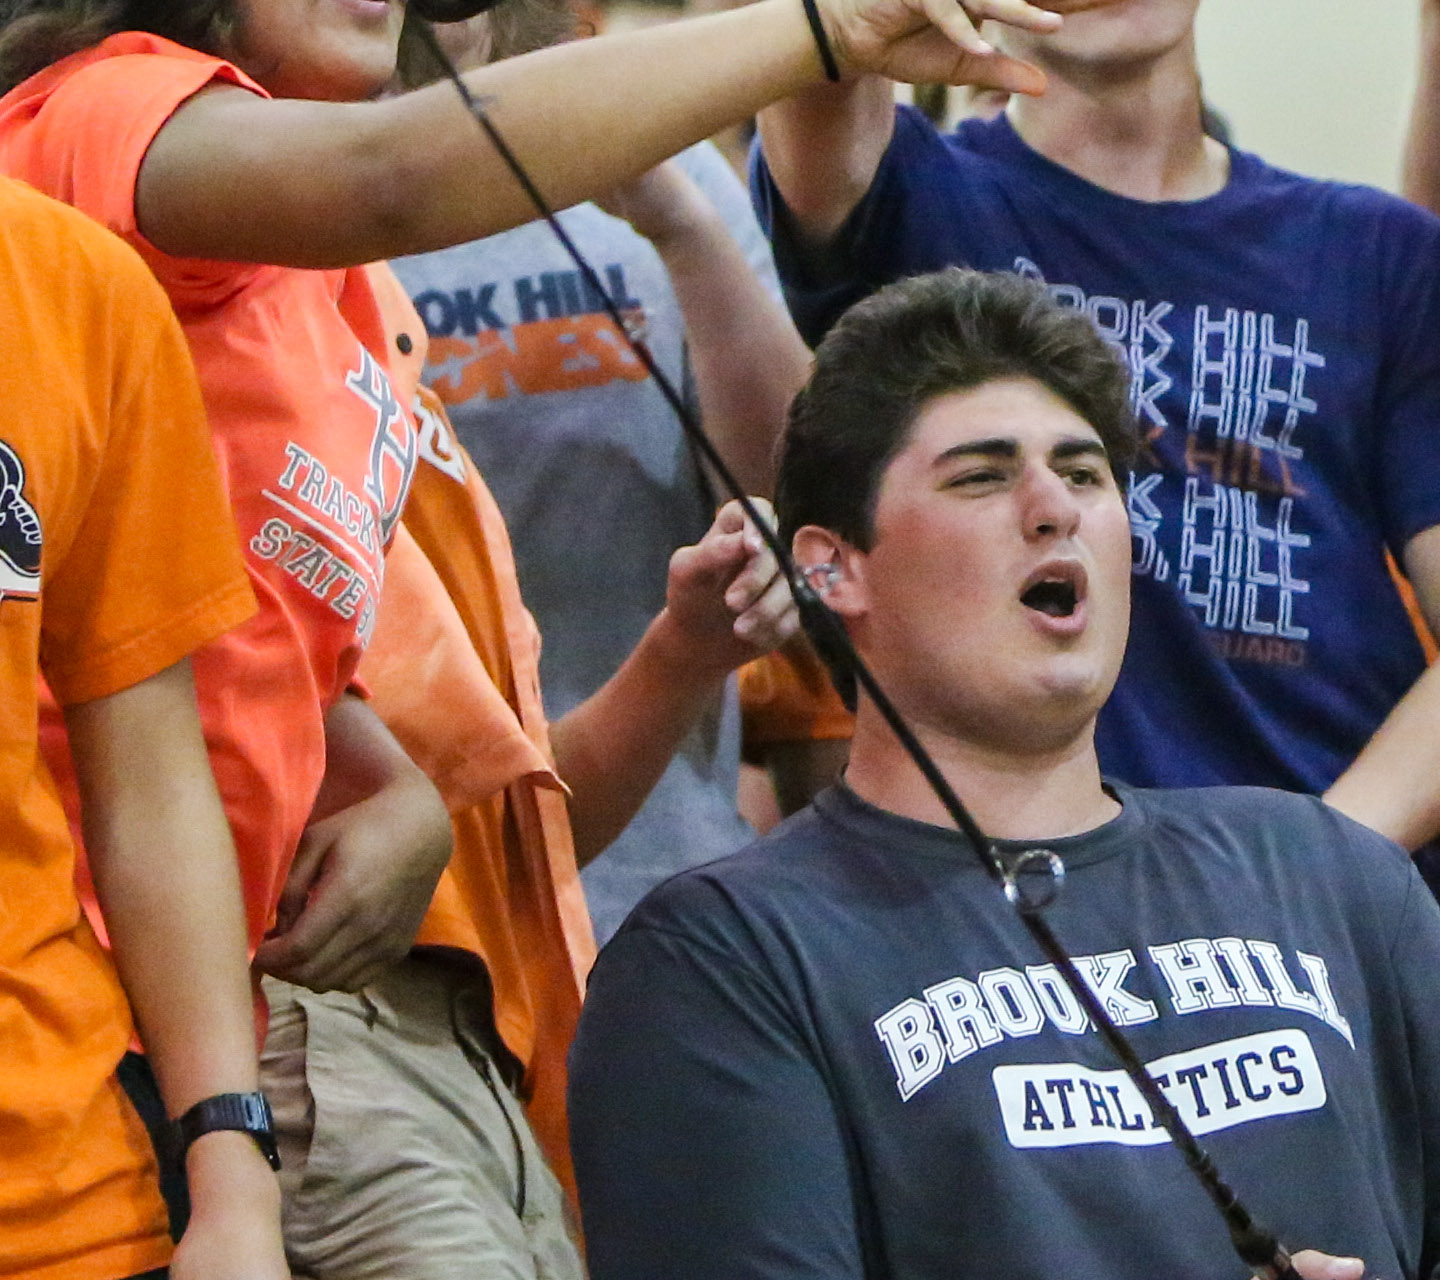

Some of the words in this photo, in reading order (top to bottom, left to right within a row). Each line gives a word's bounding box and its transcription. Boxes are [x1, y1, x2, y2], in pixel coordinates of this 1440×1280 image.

[250, 517, 367, 620] STATE
[873, 947, 1159, 1102] BROOK
[1147, 935, 1356, 1050] HILL
